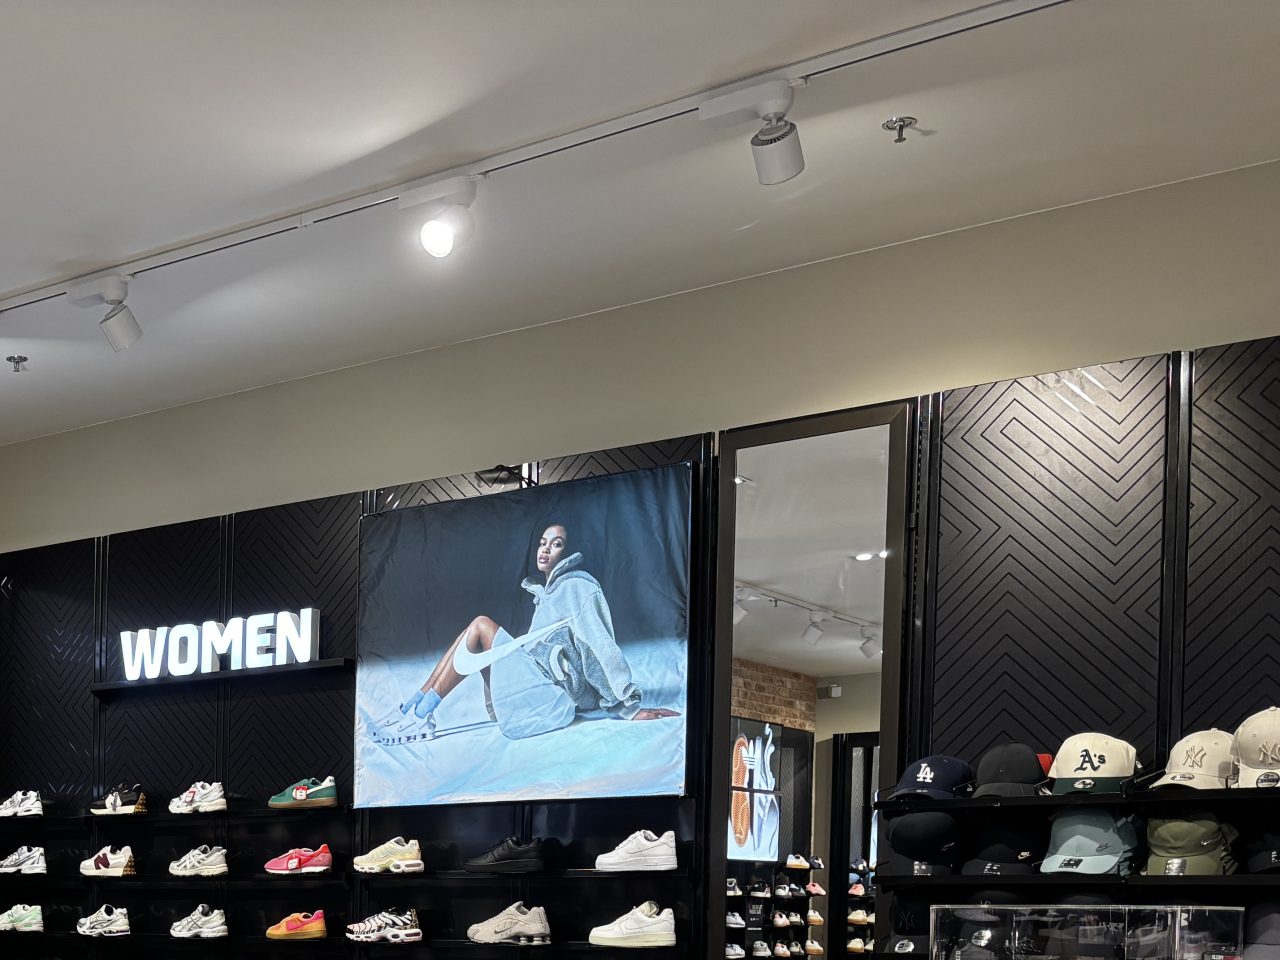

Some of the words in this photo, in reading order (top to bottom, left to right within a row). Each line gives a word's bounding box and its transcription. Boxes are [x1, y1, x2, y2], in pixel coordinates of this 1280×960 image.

[120, 607, 321, 681] WOMEN
[1074, 748, 1106, 772] A's
[916, 763, 934, 783] LA
